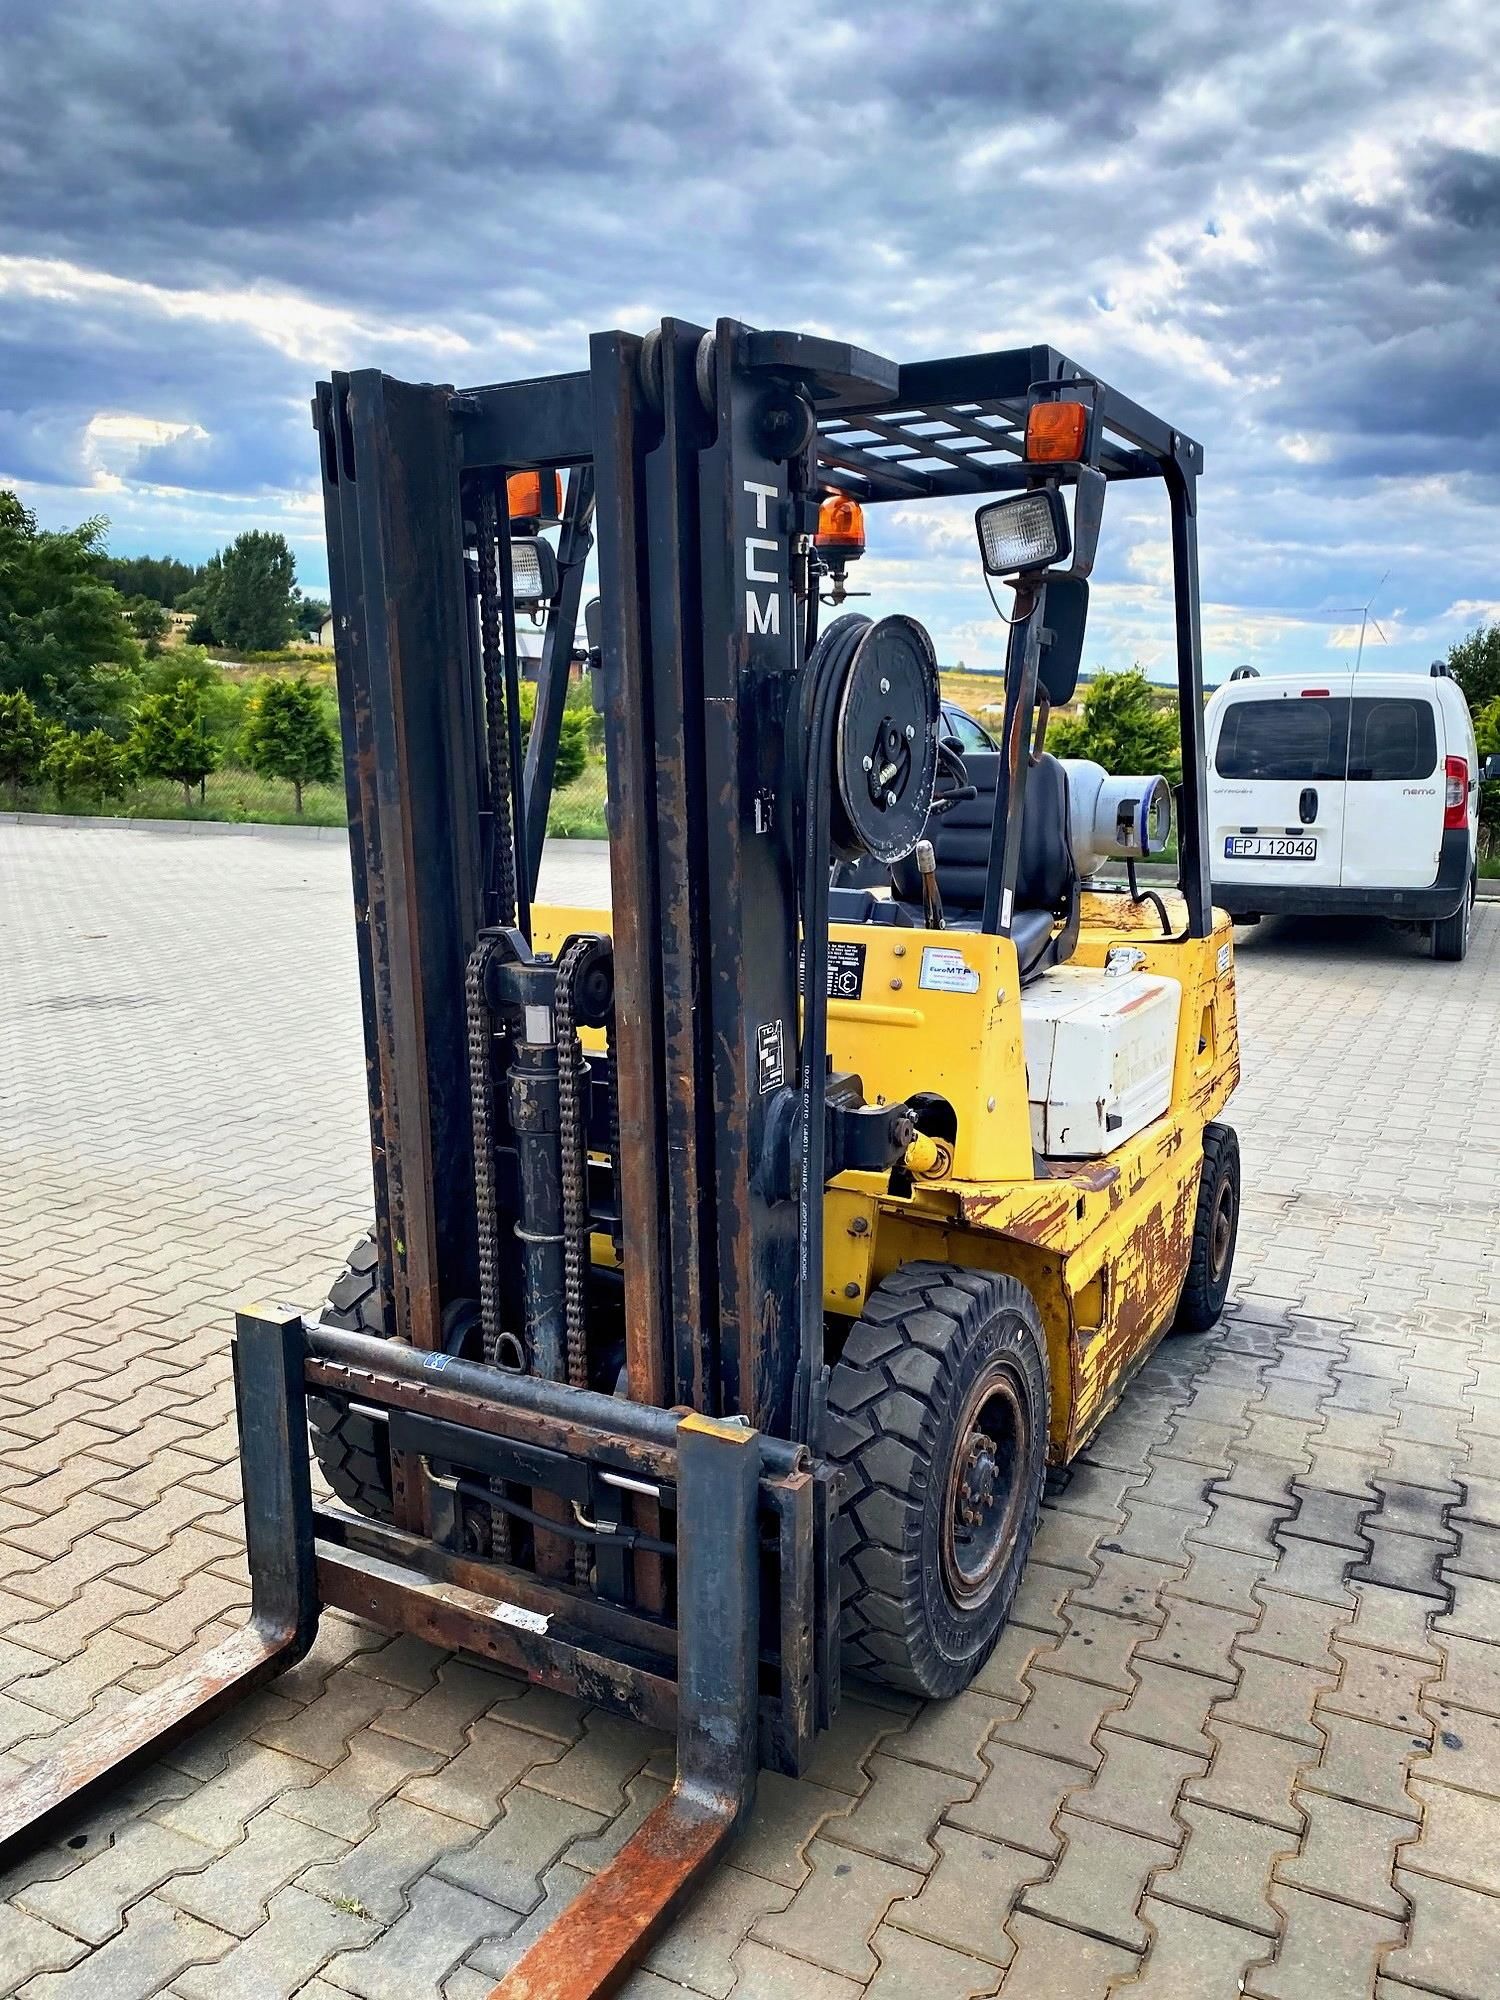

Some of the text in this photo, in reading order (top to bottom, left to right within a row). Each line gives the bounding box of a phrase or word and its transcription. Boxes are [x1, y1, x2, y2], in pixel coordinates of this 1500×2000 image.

[743, 480, 780, 635] TCM
[1234, 839, 1313, 856] EPJ 12046
